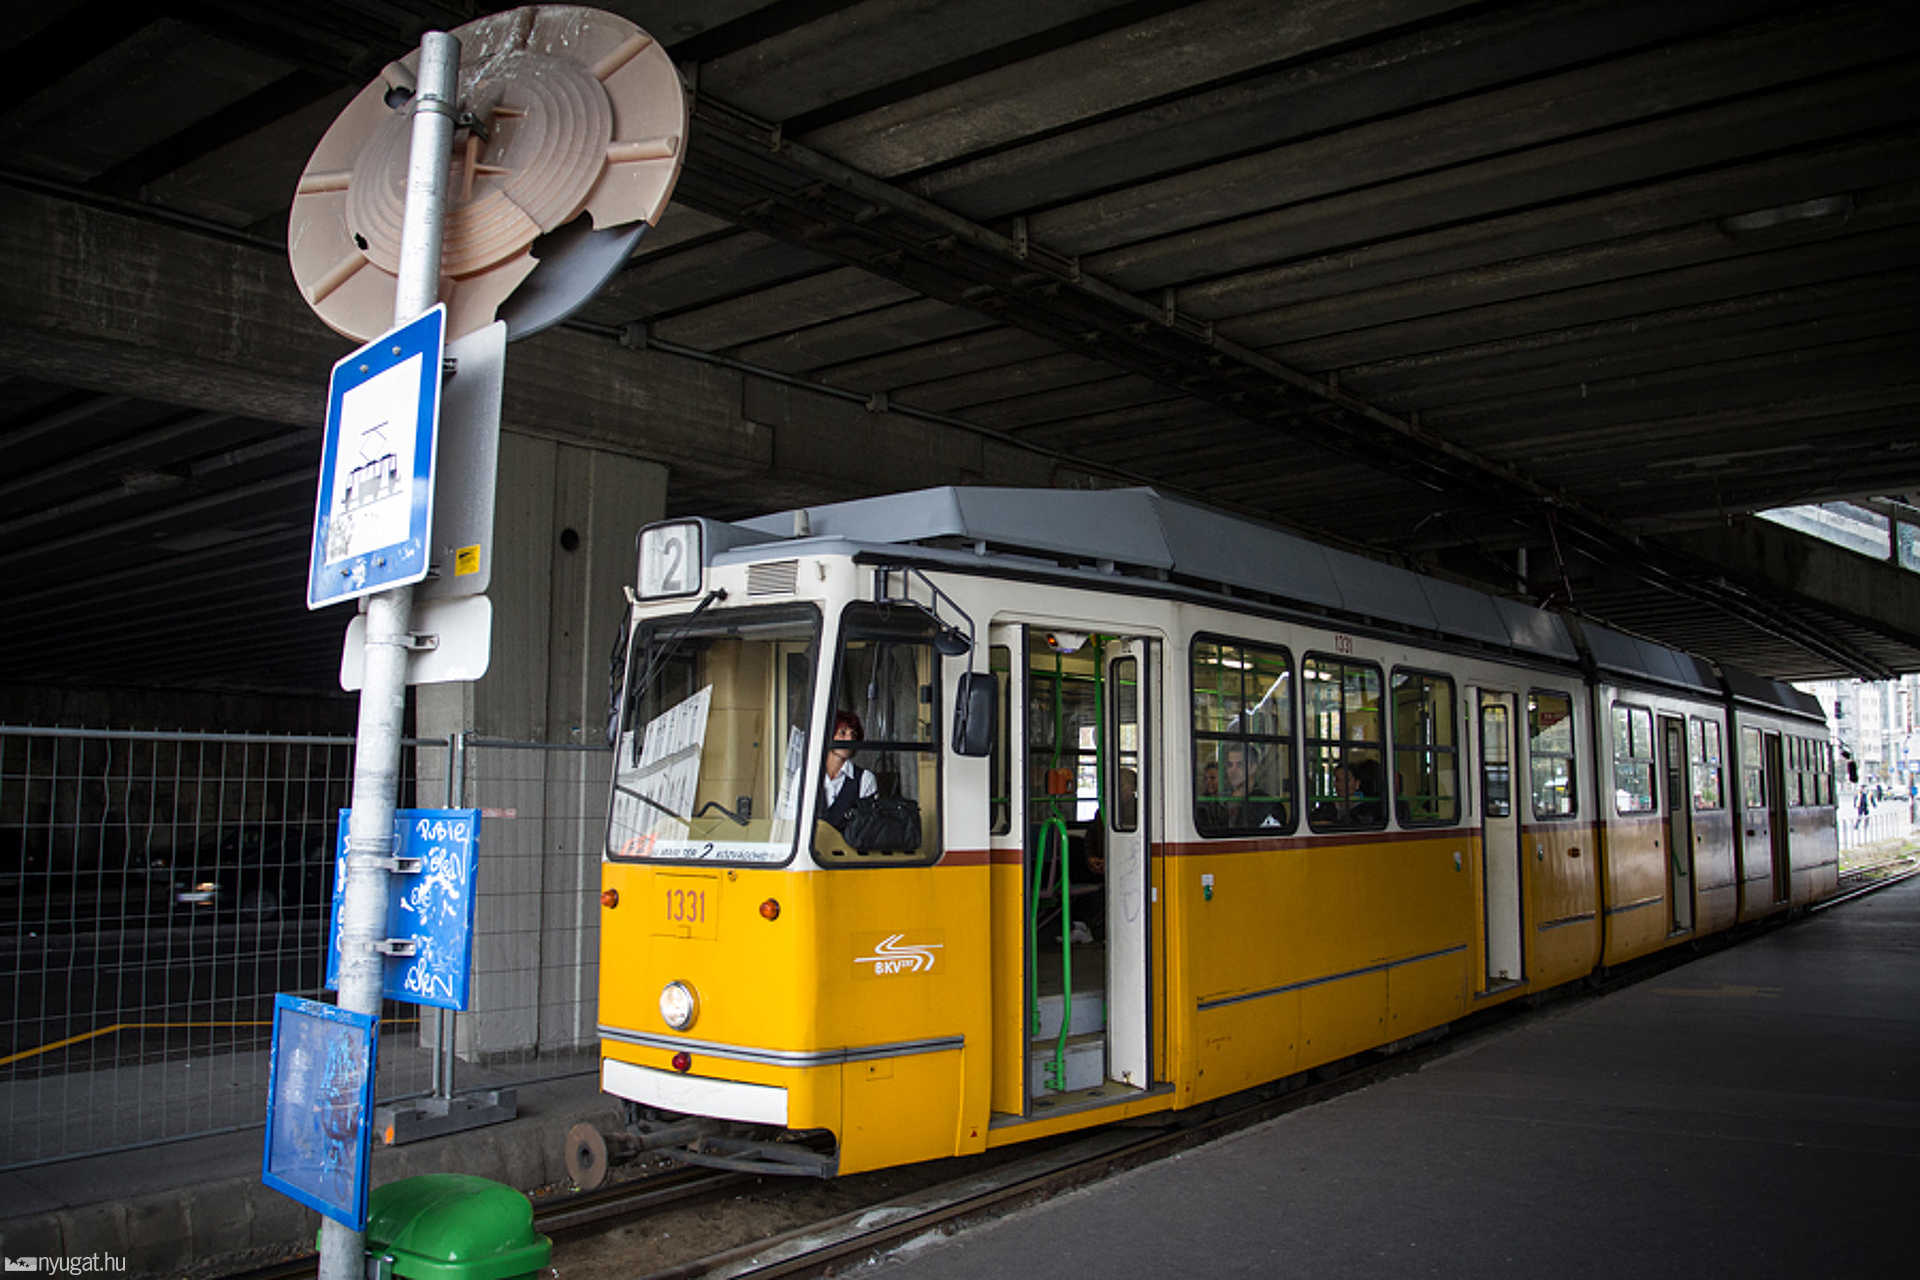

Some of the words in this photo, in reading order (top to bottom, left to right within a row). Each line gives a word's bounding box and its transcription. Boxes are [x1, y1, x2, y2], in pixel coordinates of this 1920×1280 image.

[662, 537, 683, 592] 2
[1335, 633, 1353, 655] 1331
[666, 889, 705, 923] 1331
[874, 960, 901, 975] BKV
